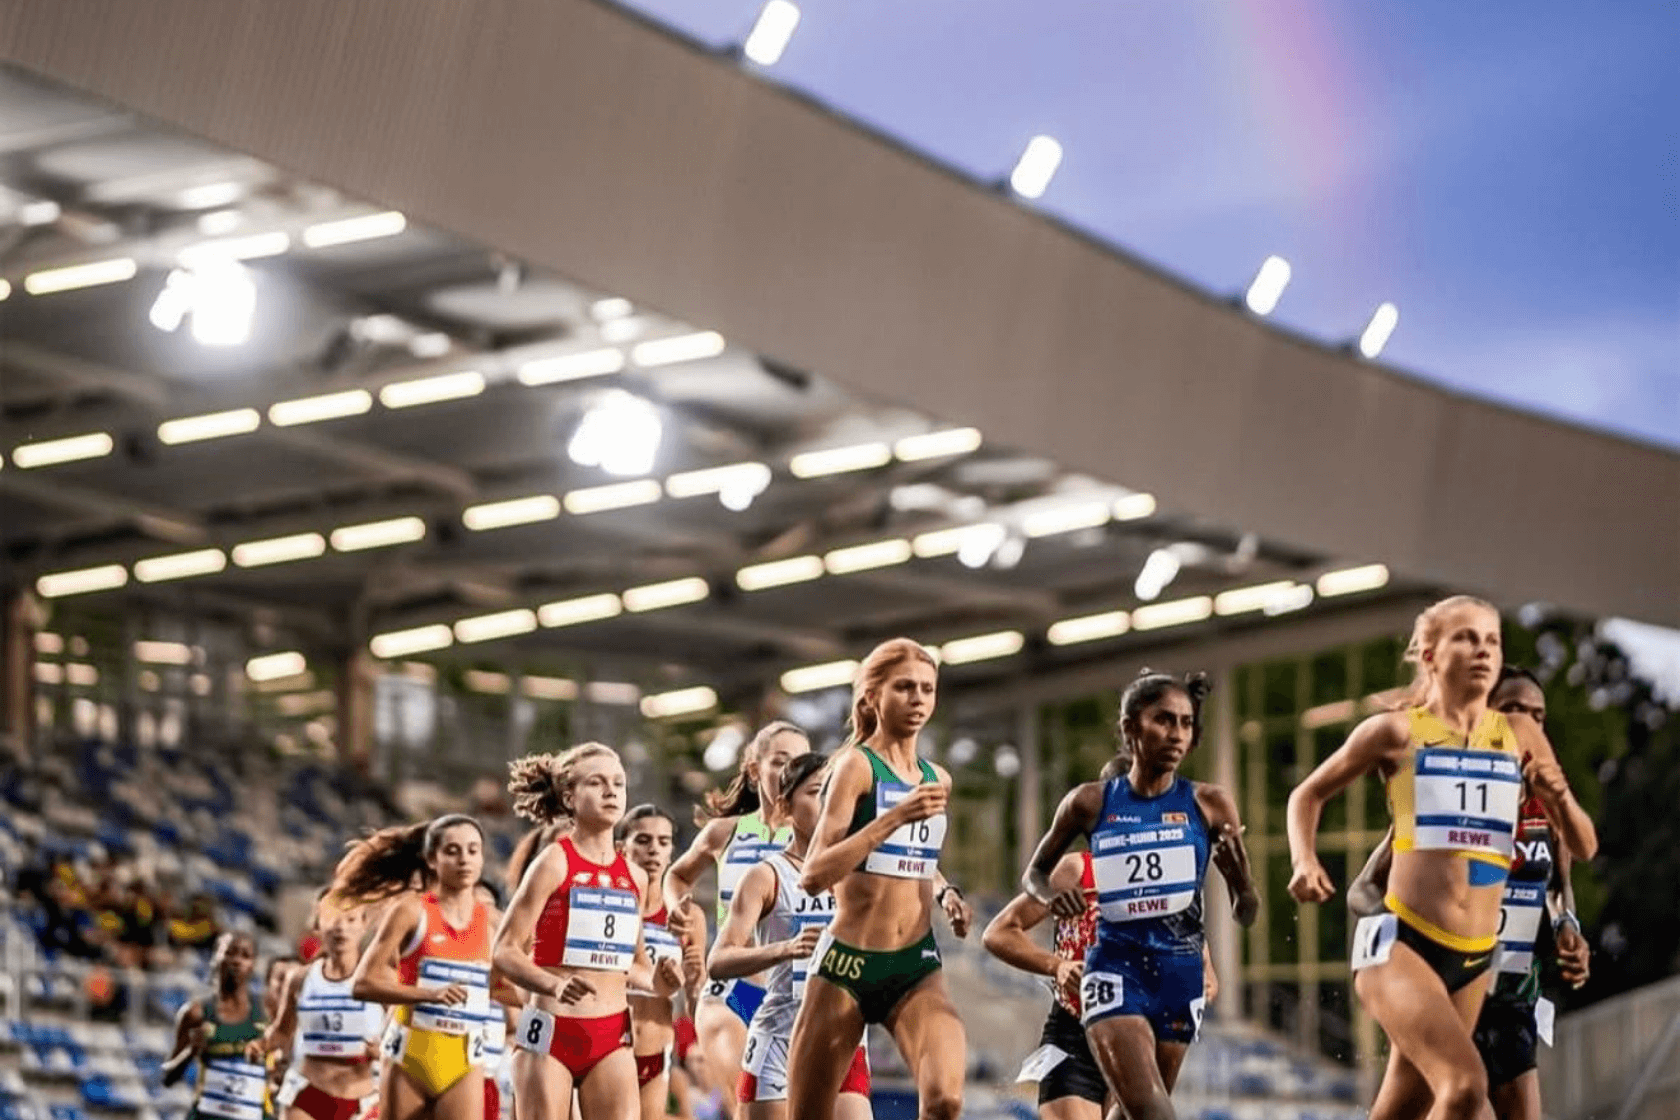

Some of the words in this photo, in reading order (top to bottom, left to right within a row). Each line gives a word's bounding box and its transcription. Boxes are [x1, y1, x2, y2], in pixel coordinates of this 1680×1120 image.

[1455, 781, 1487, 813] 11
[1448, 830, 1490, 846] REWE
[897, 859, 925, 873] REWE
[1125, 852, 1163, 884] 28
[1127, 898, 1169, 915] REWE
[603, 914, 616, 938] 8
[590, 953, 619, 966] REWE
[822, 951, 865, 980] AUS
[1084, 979, 1116, 1012] 28
[526, 1018, 543, 1044] 8
